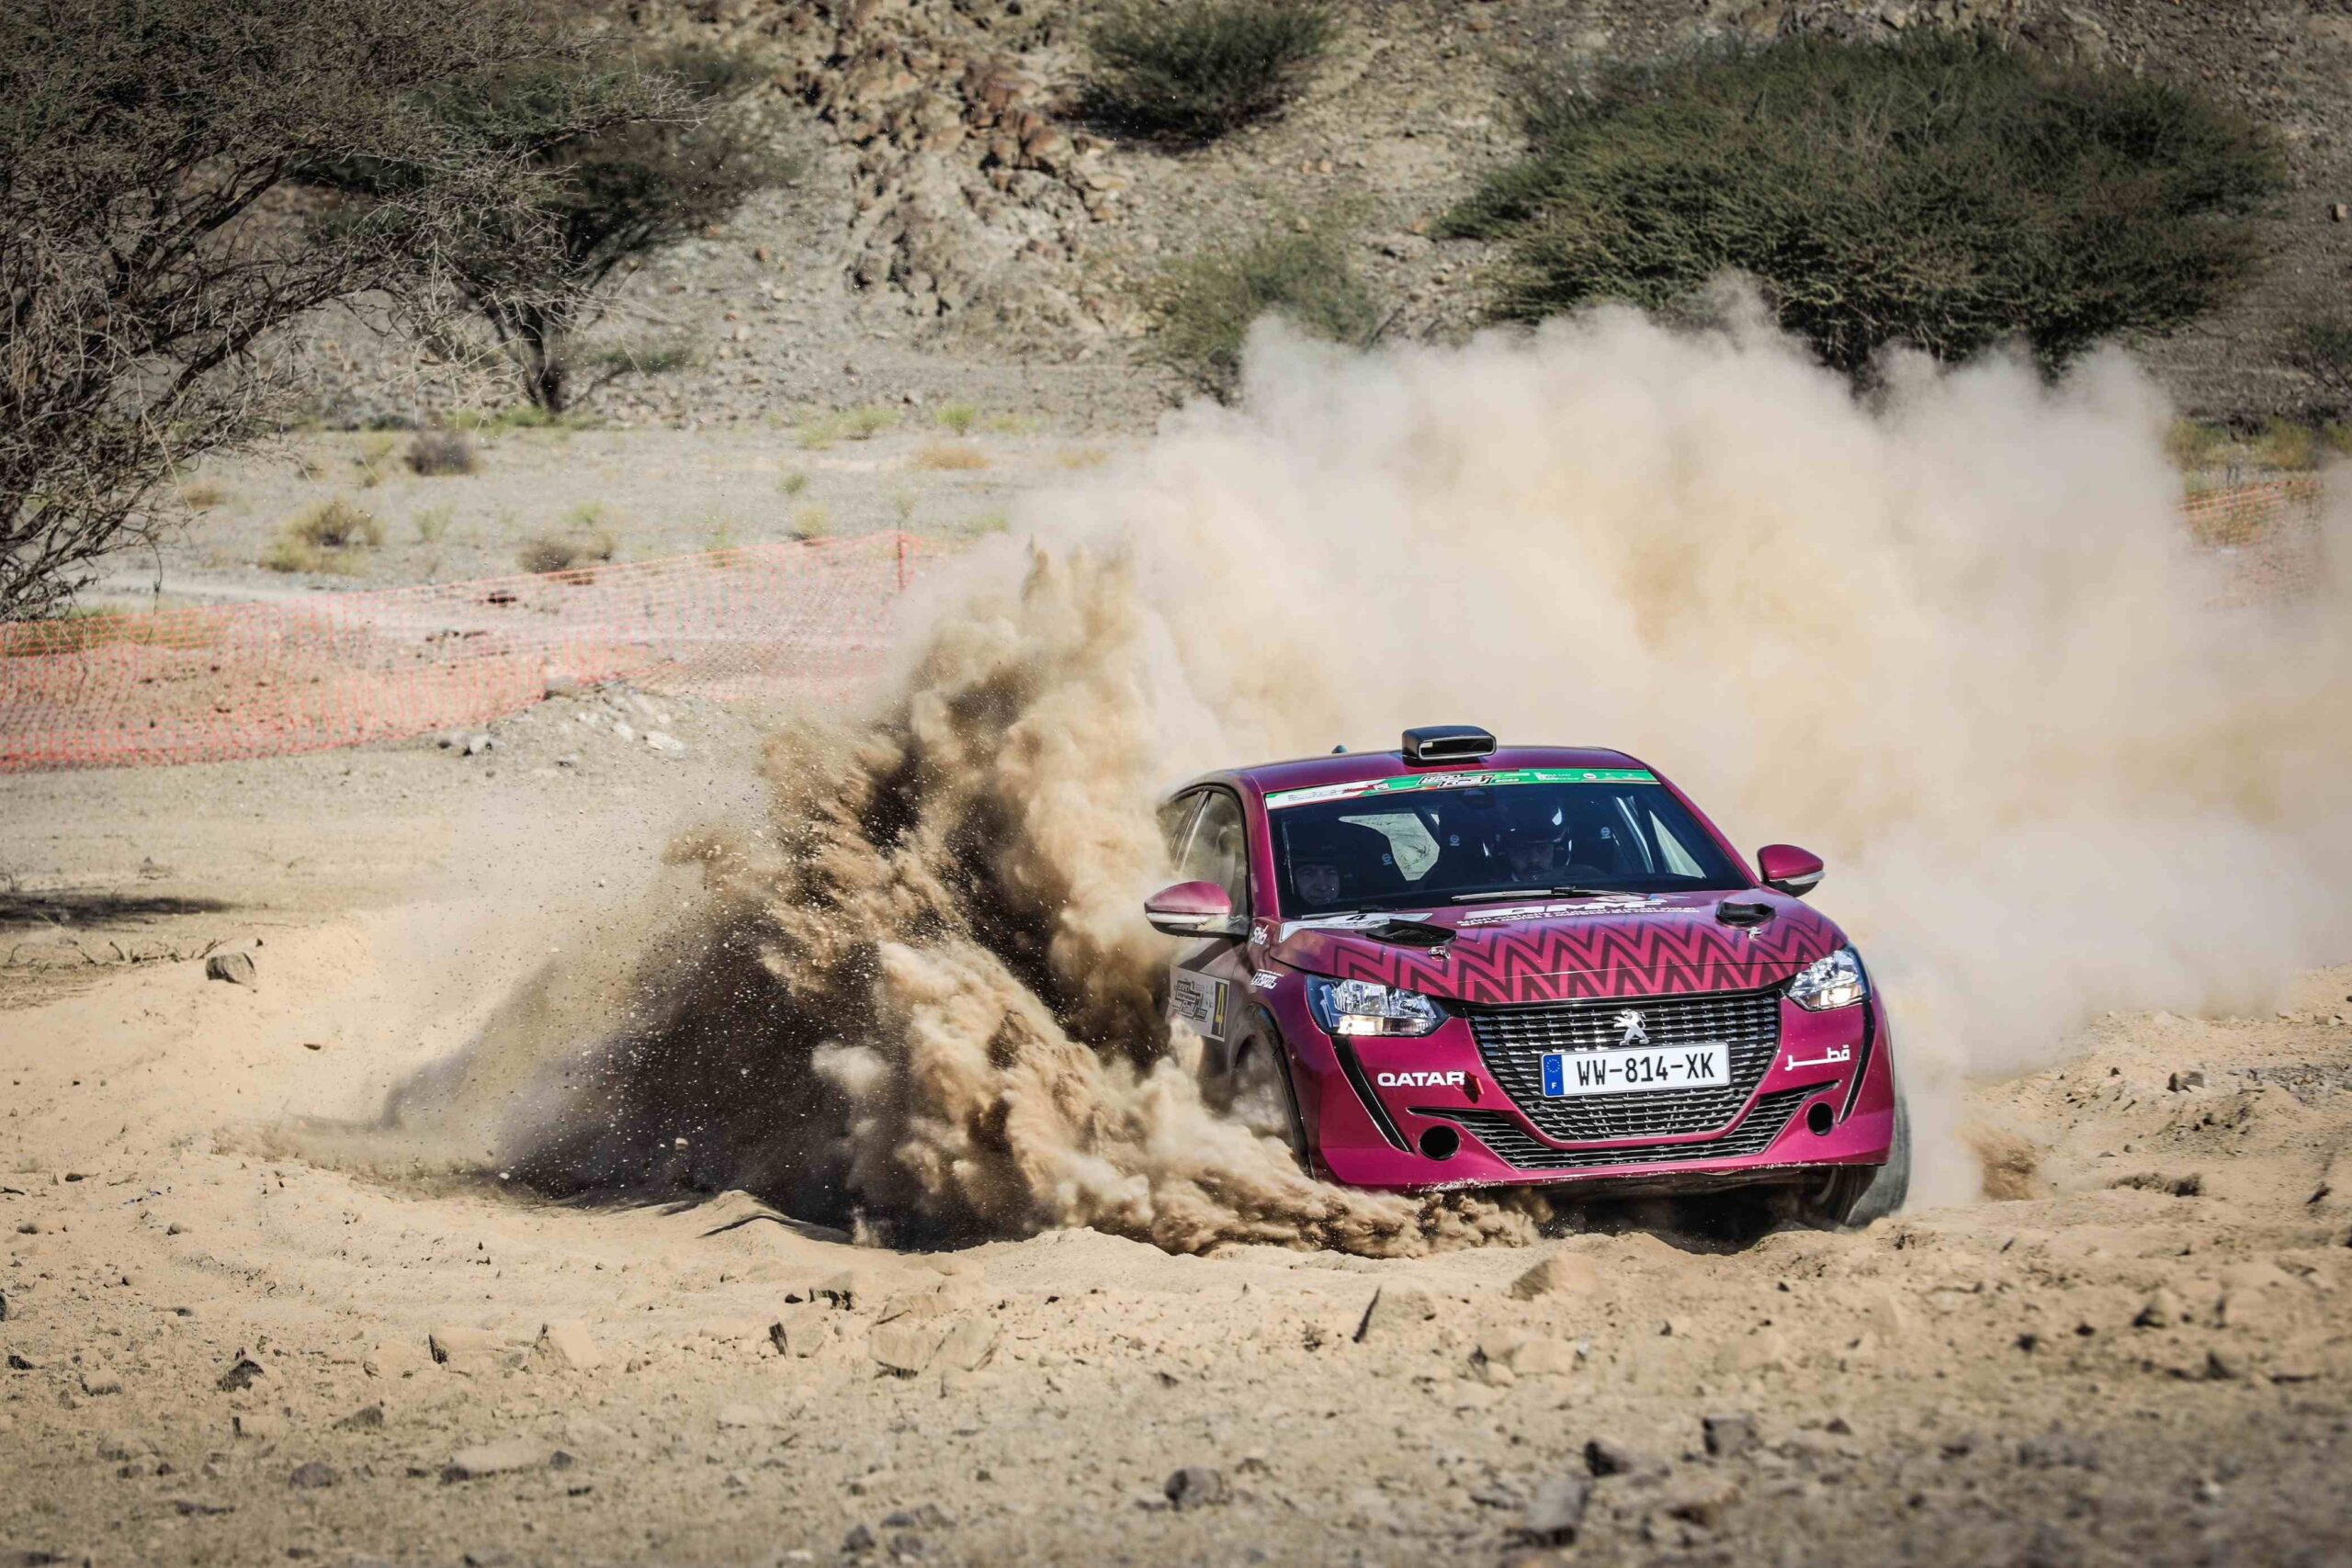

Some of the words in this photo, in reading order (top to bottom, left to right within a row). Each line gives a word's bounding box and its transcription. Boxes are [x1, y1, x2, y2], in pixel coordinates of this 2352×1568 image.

[1214, 984, 1225, 1034] 4
[1577, 1052, 1715, 1087] WW-814-XK
[1784, 1043, 1850, 1072] قطر
[1377, 1070, 1465, 1087] QATAR
